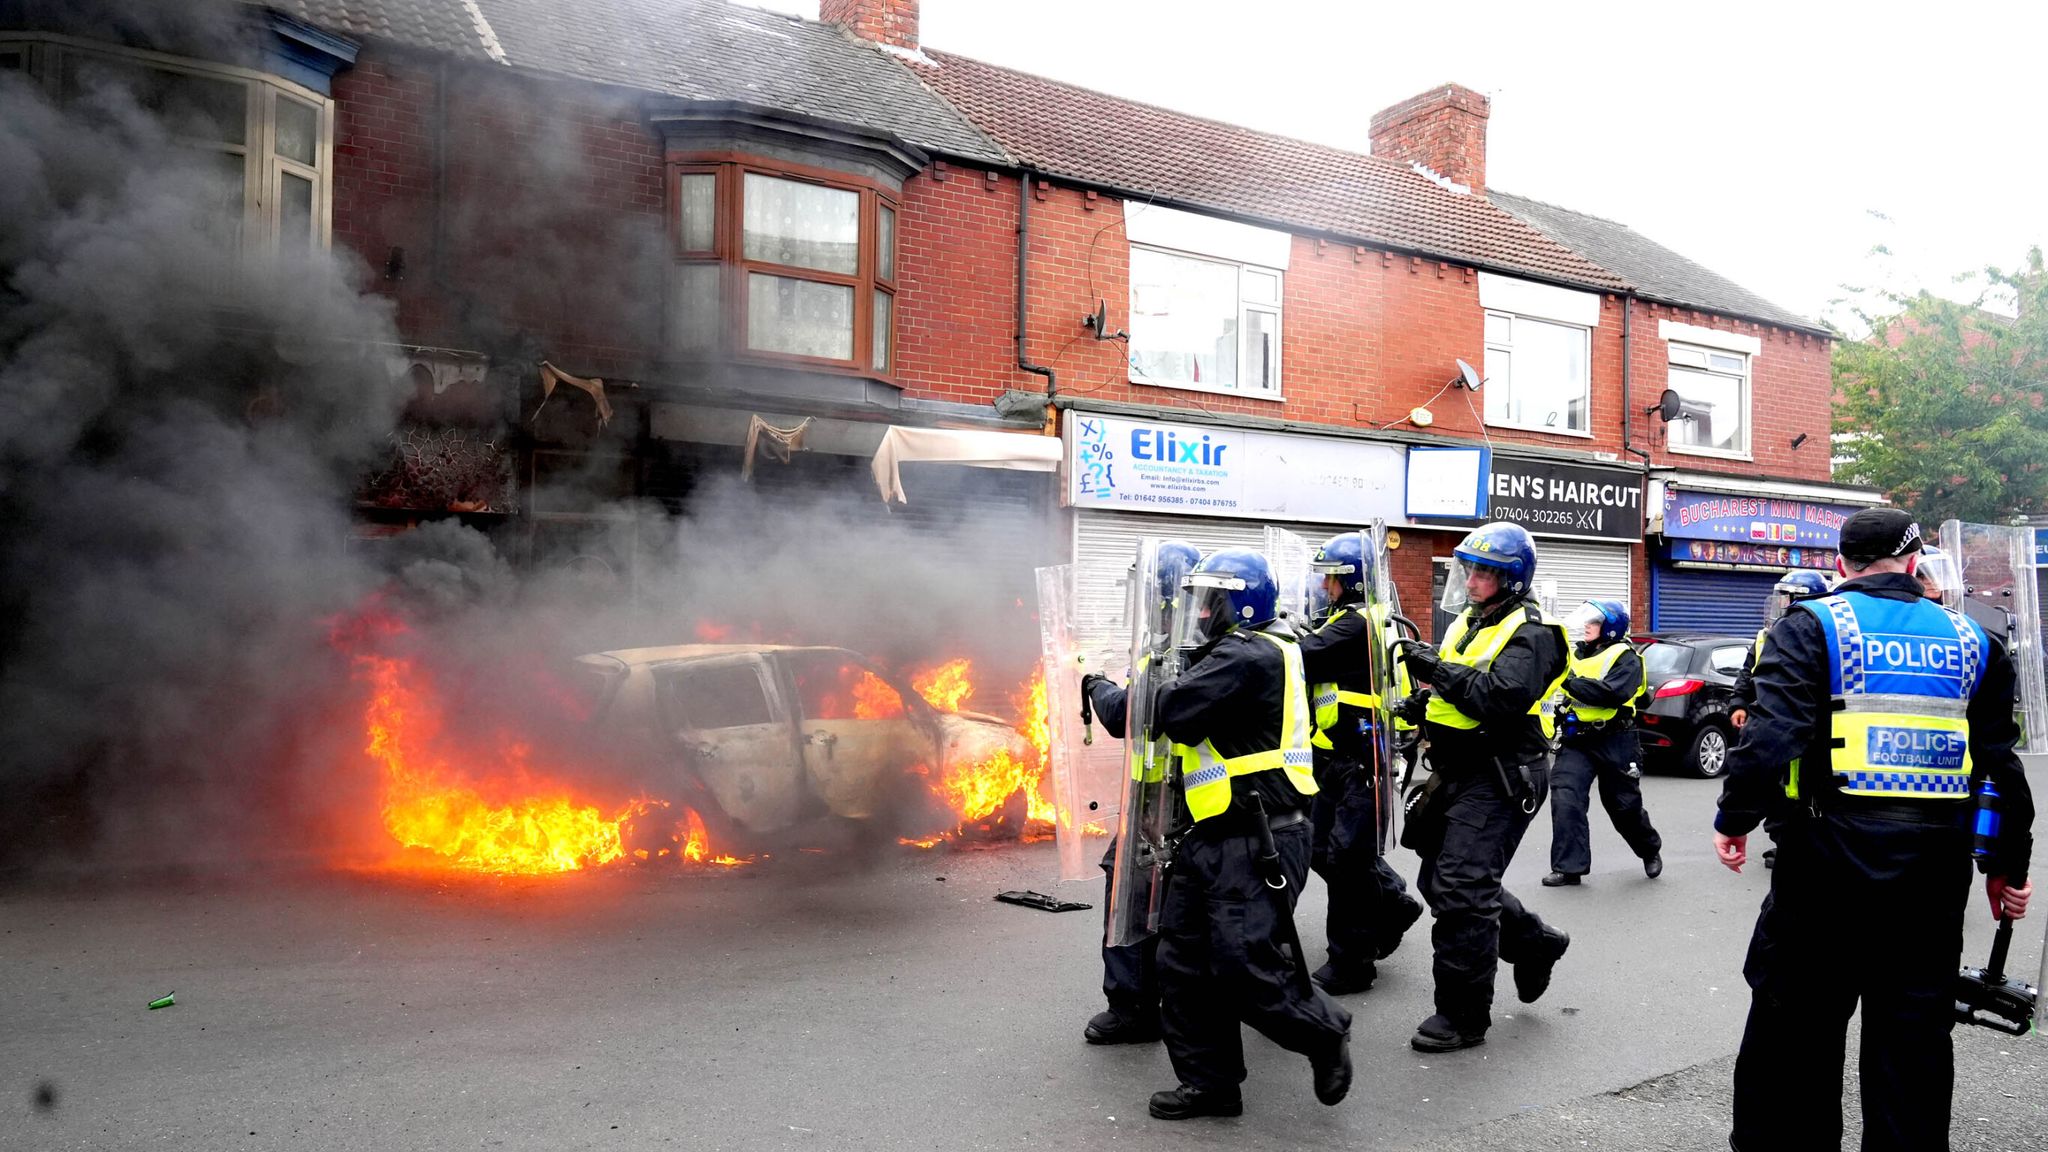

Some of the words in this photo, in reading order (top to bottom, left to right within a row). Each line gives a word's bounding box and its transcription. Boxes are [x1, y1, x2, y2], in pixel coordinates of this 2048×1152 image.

[1131, 429, 1228, 467] Elixir
[1133, 463, 1187, 475] ACCOUNTANCY
[1196, 469, 1228, 478] TAXATION
[1150, 483, 1206, 492] www.elixirbs.com
[1550, 479, 1641, 509] HAIRCUT
[1119, 493, 1132, 501] Tel:
[1134, 494, 1156, 503] 01642
[1158, 495, 1184, 504] 956385
[1190, 498, 1211, 506] 07404
[1213, 499, 1237, 507] 876755
[1495, 506, 1530, 521] 07404
[1532, 509, 1573, 525] 302265
[1680, 499, 1767, 526] BUCHAREST
[1771, 500, 1801, 519] MINI
[1866, 640, 1960, 670] POLICE
[1877, 730, 1959, 752] POLICE
[1873, 752, 1934, 765] FOOTBALL
[1937, 756, 1960, 766] UNIT
